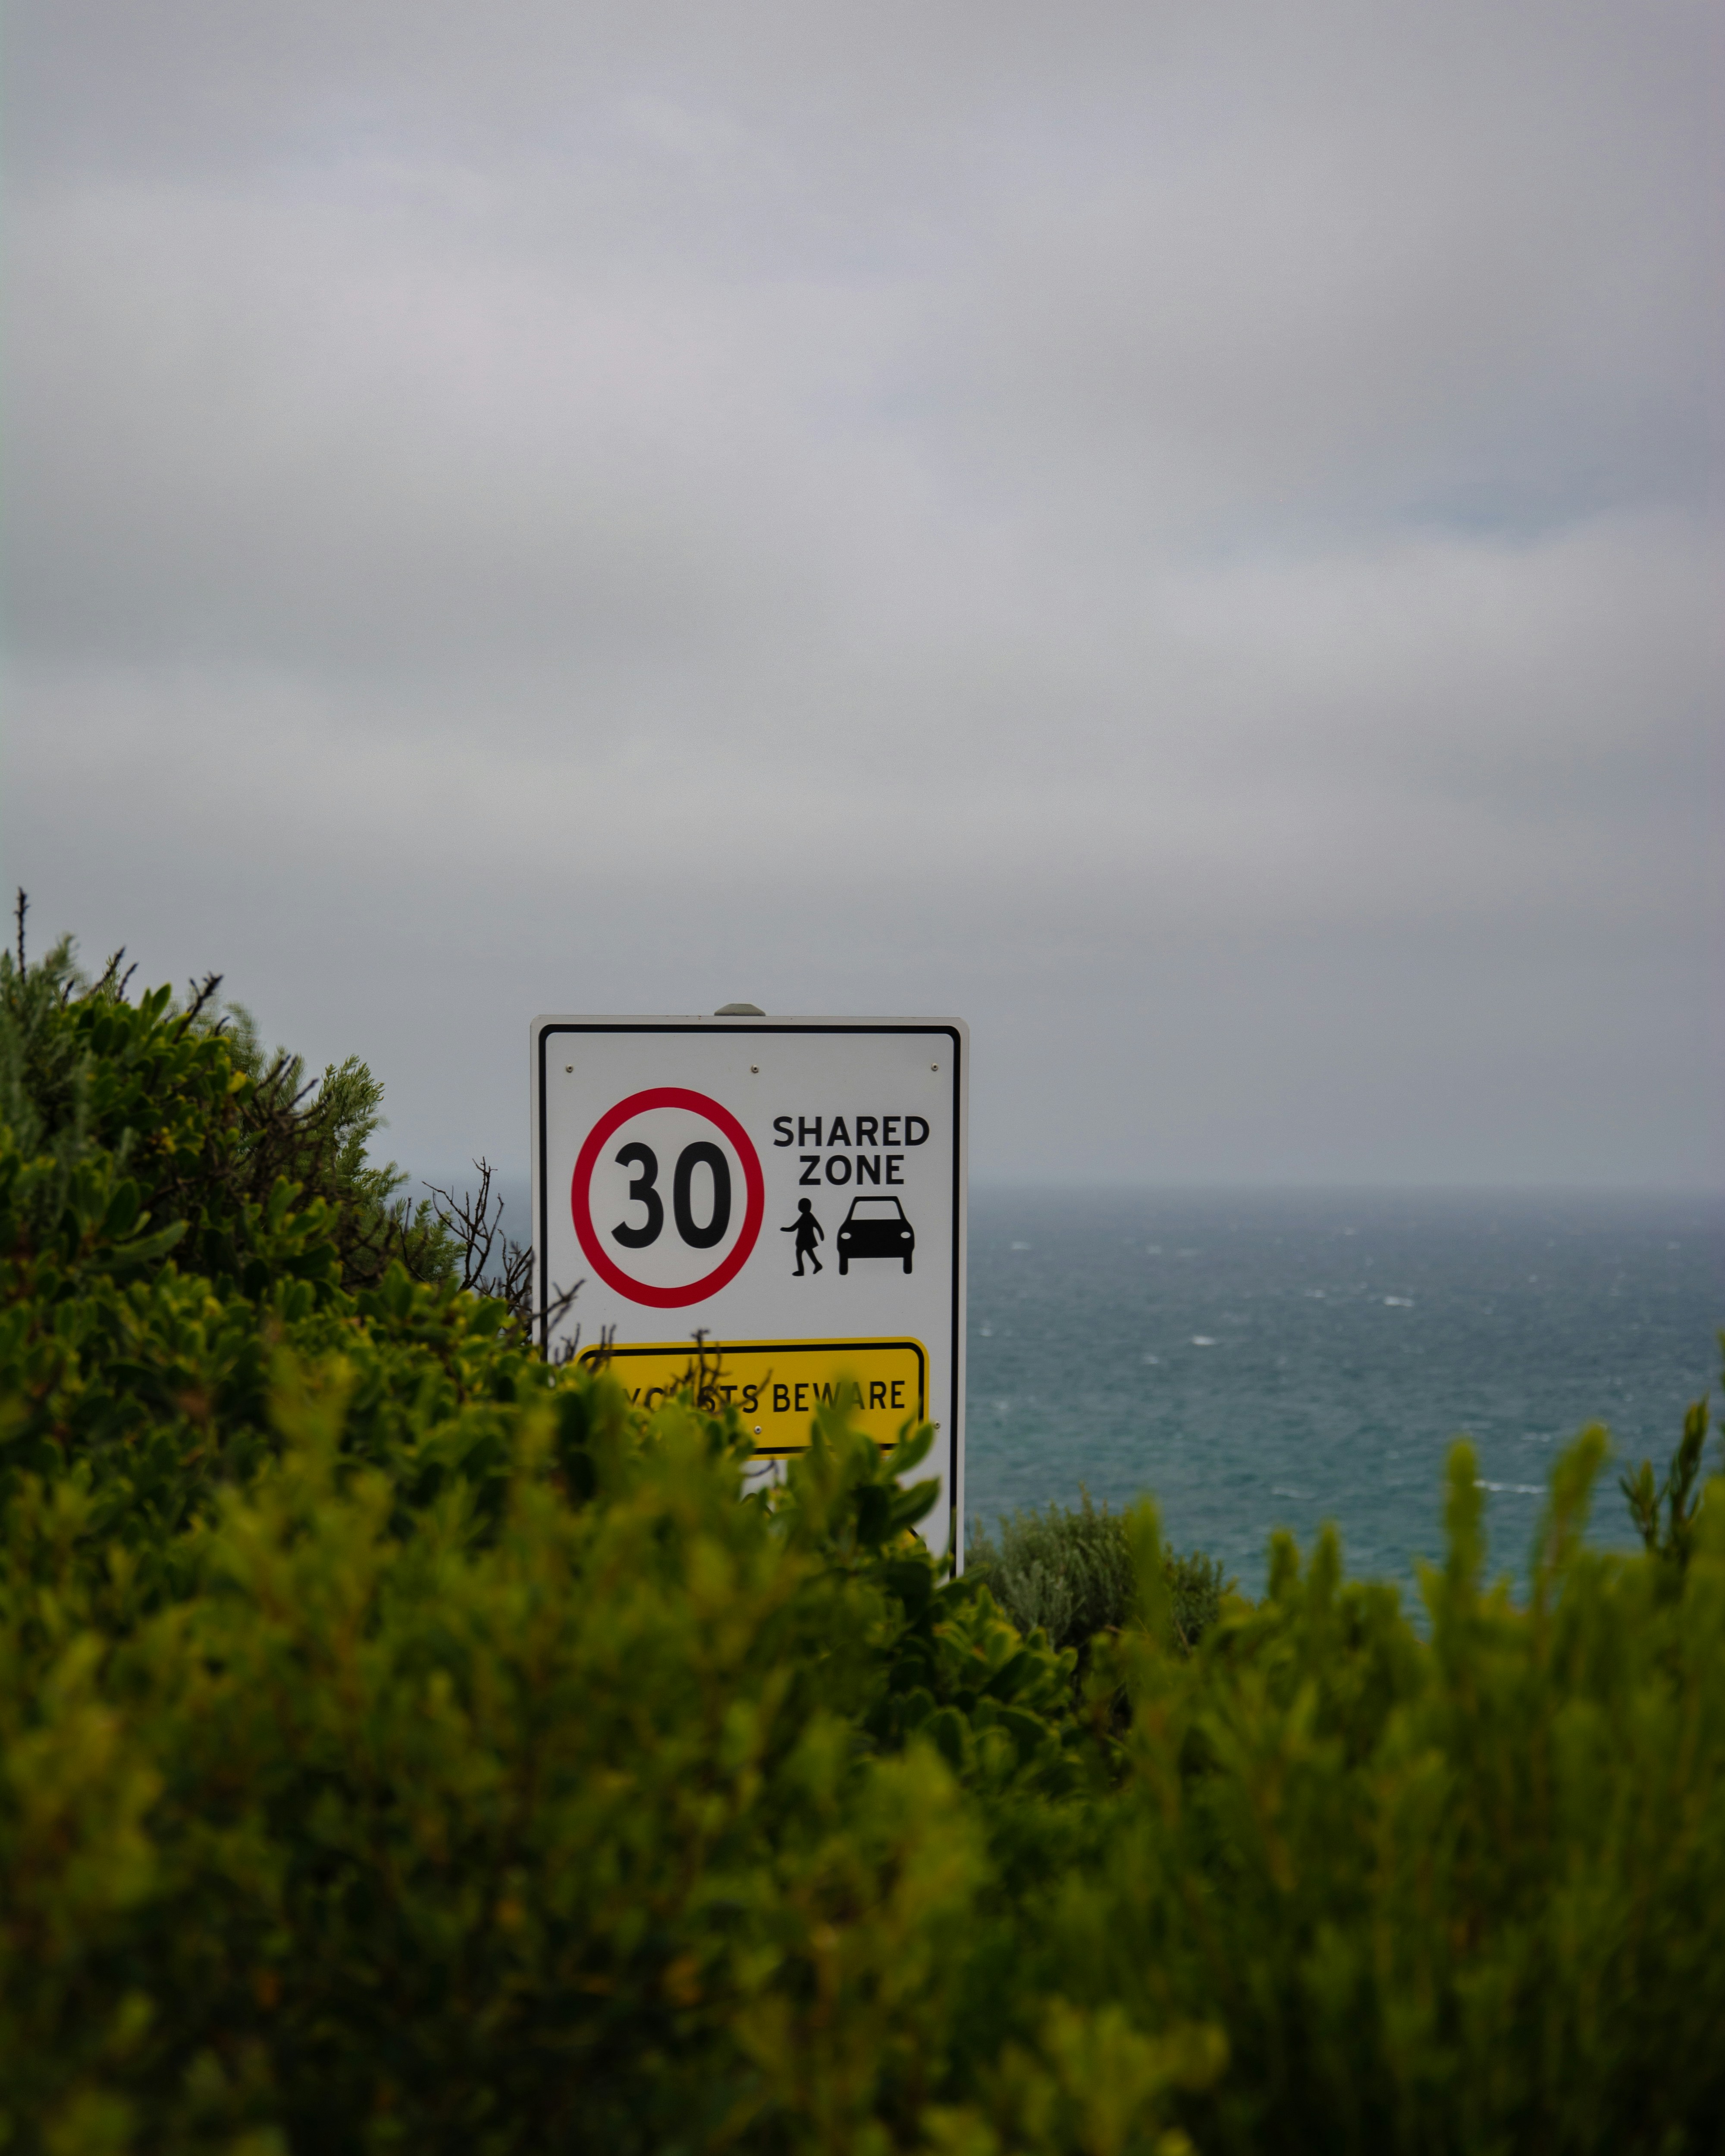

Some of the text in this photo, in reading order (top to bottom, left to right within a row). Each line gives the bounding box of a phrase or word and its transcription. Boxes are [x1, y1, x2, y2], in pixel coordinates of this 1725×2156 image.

[773, 1116, 929, 1147] SHARED
[799, 1155, 904, 1185] ZONE
[611, 1141, 731, 1249] 30
